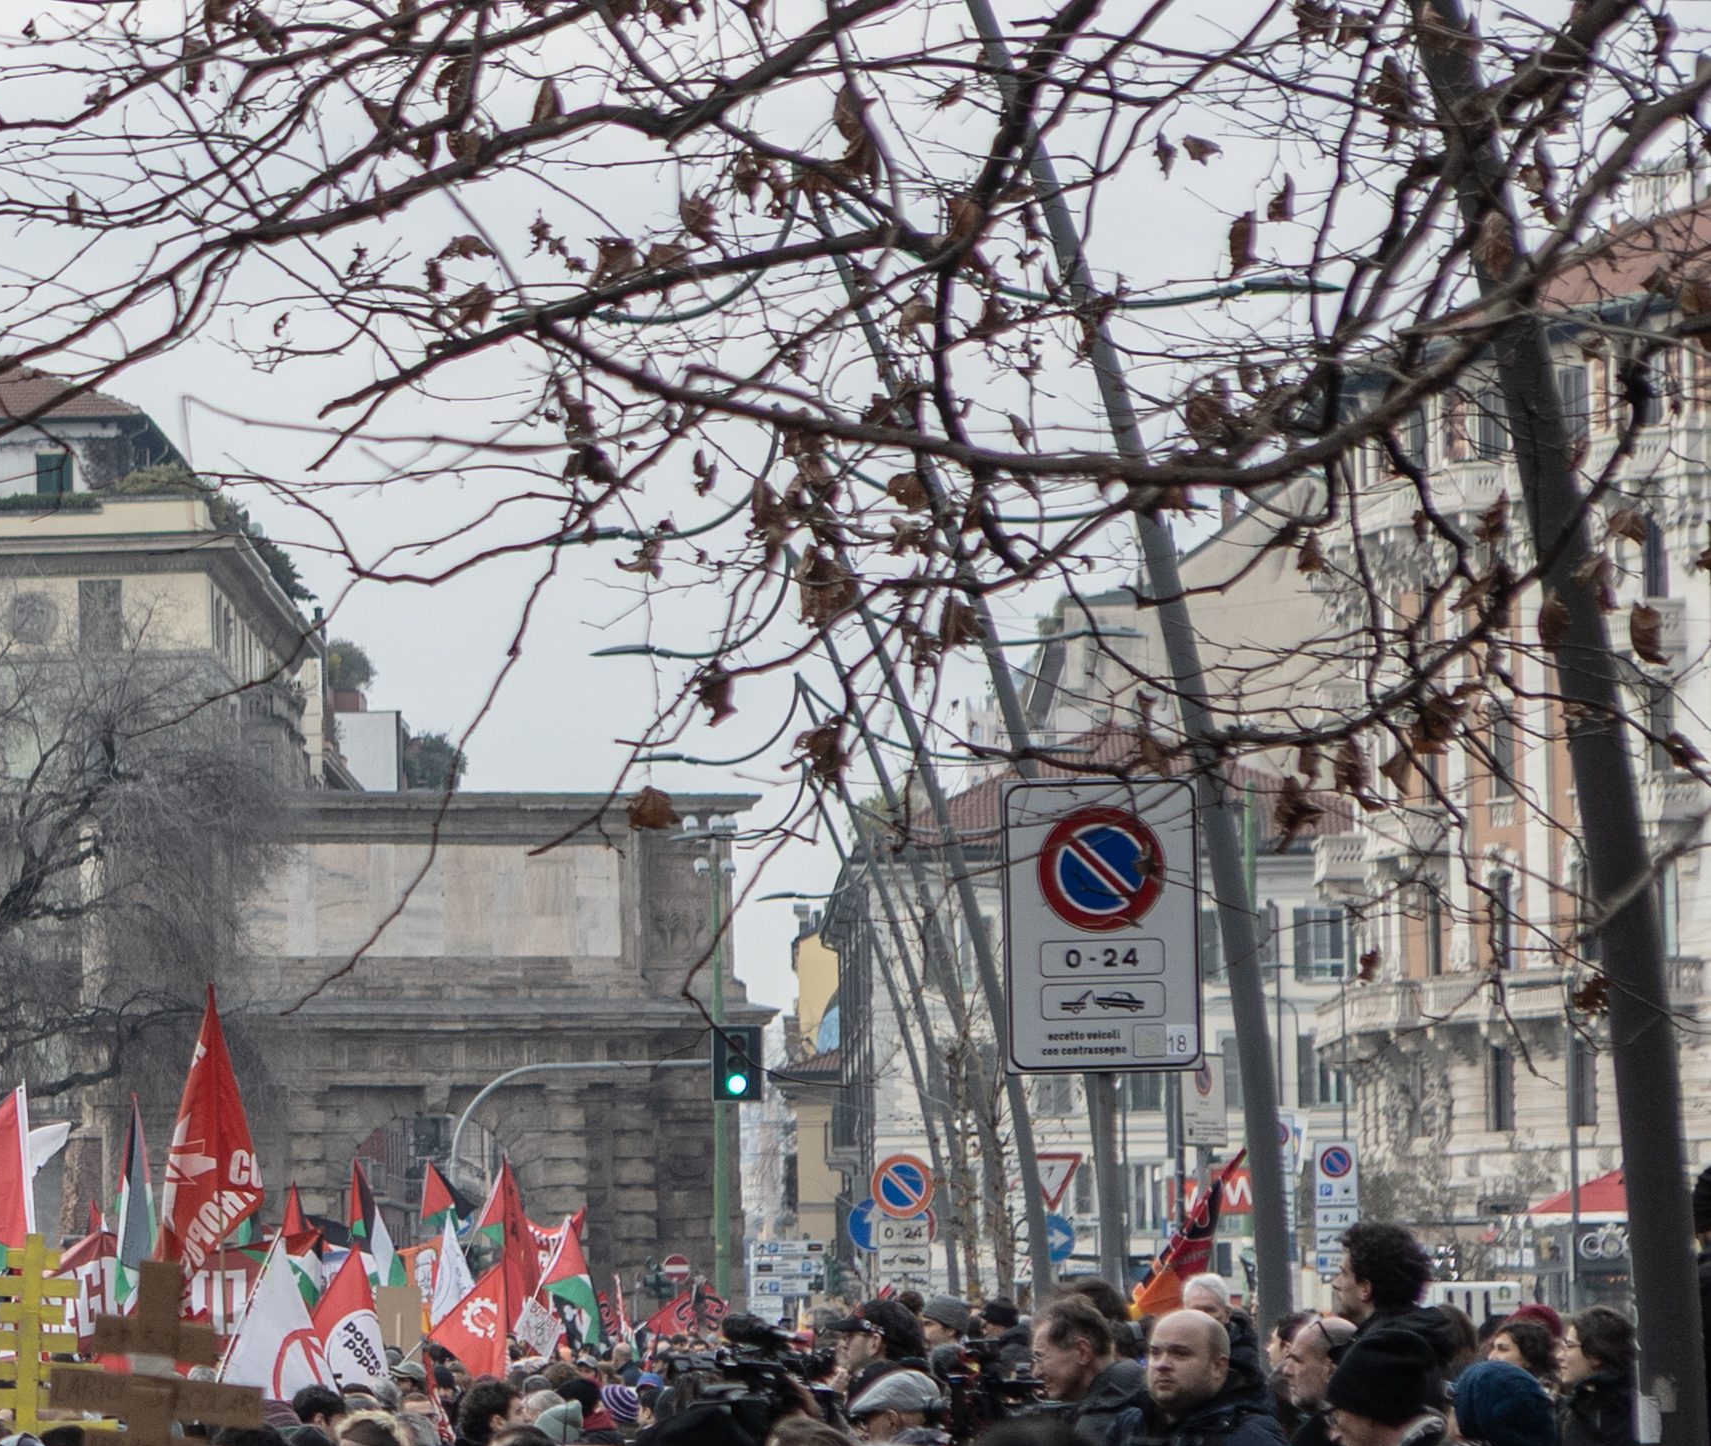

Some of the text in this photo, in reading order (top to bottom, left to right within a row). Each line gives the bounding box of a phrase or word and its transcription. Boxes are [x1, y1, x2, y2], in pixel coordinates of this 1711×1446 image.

[1047, 1029, 1121, 1041] eccetto veicoli
[1041, 1044, 1128, 1057] con contrassegno
[1167, 1034, 1188, 1053] 18
[343, 1320, 381, 1371] potere
